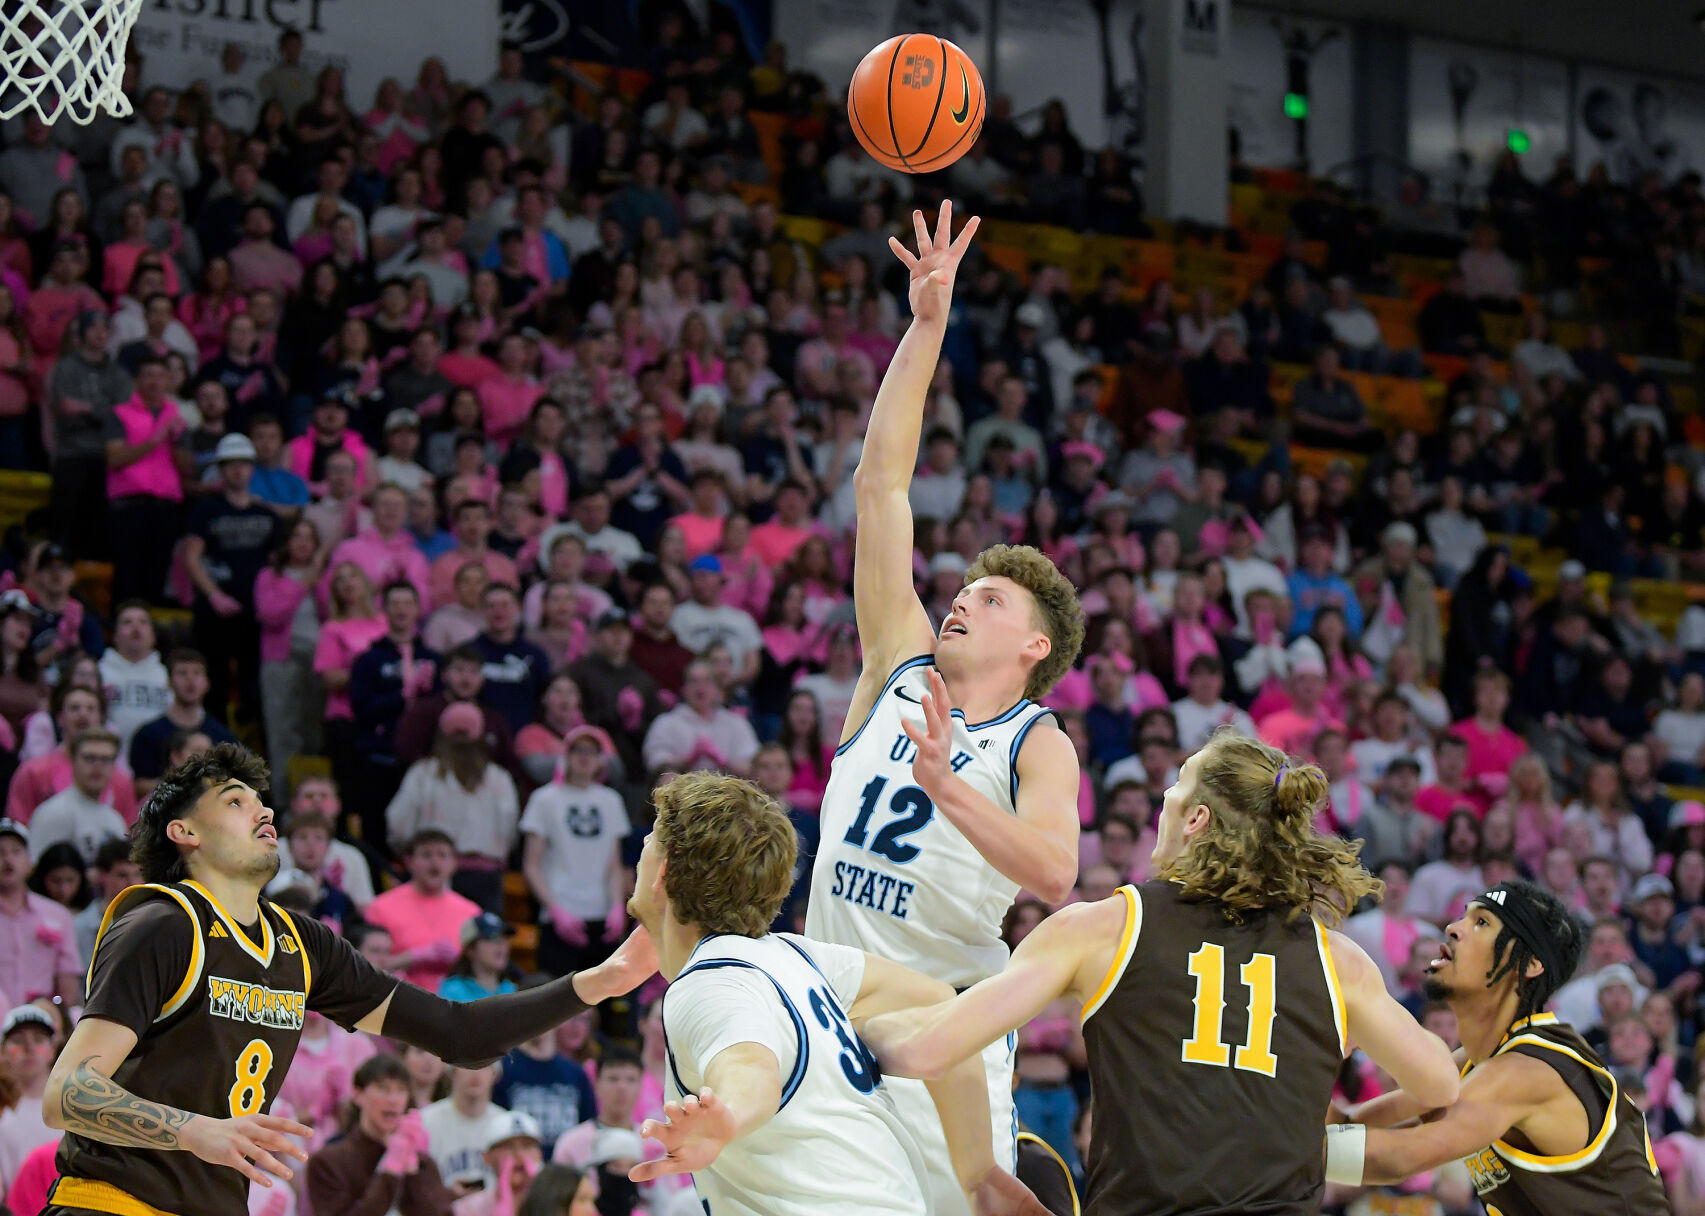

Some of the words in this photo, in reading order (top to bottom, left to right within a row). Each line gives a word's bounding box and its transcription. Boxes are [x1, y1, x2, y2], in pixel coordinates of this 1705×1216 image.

[889, 734, 974, 773] UH
[843, 774, 935, 865] 12
[831, 860, 915, 920] STATE
[1181, 941, 1278, 1078] 11
[228, 1038, 273, 1118] 8
